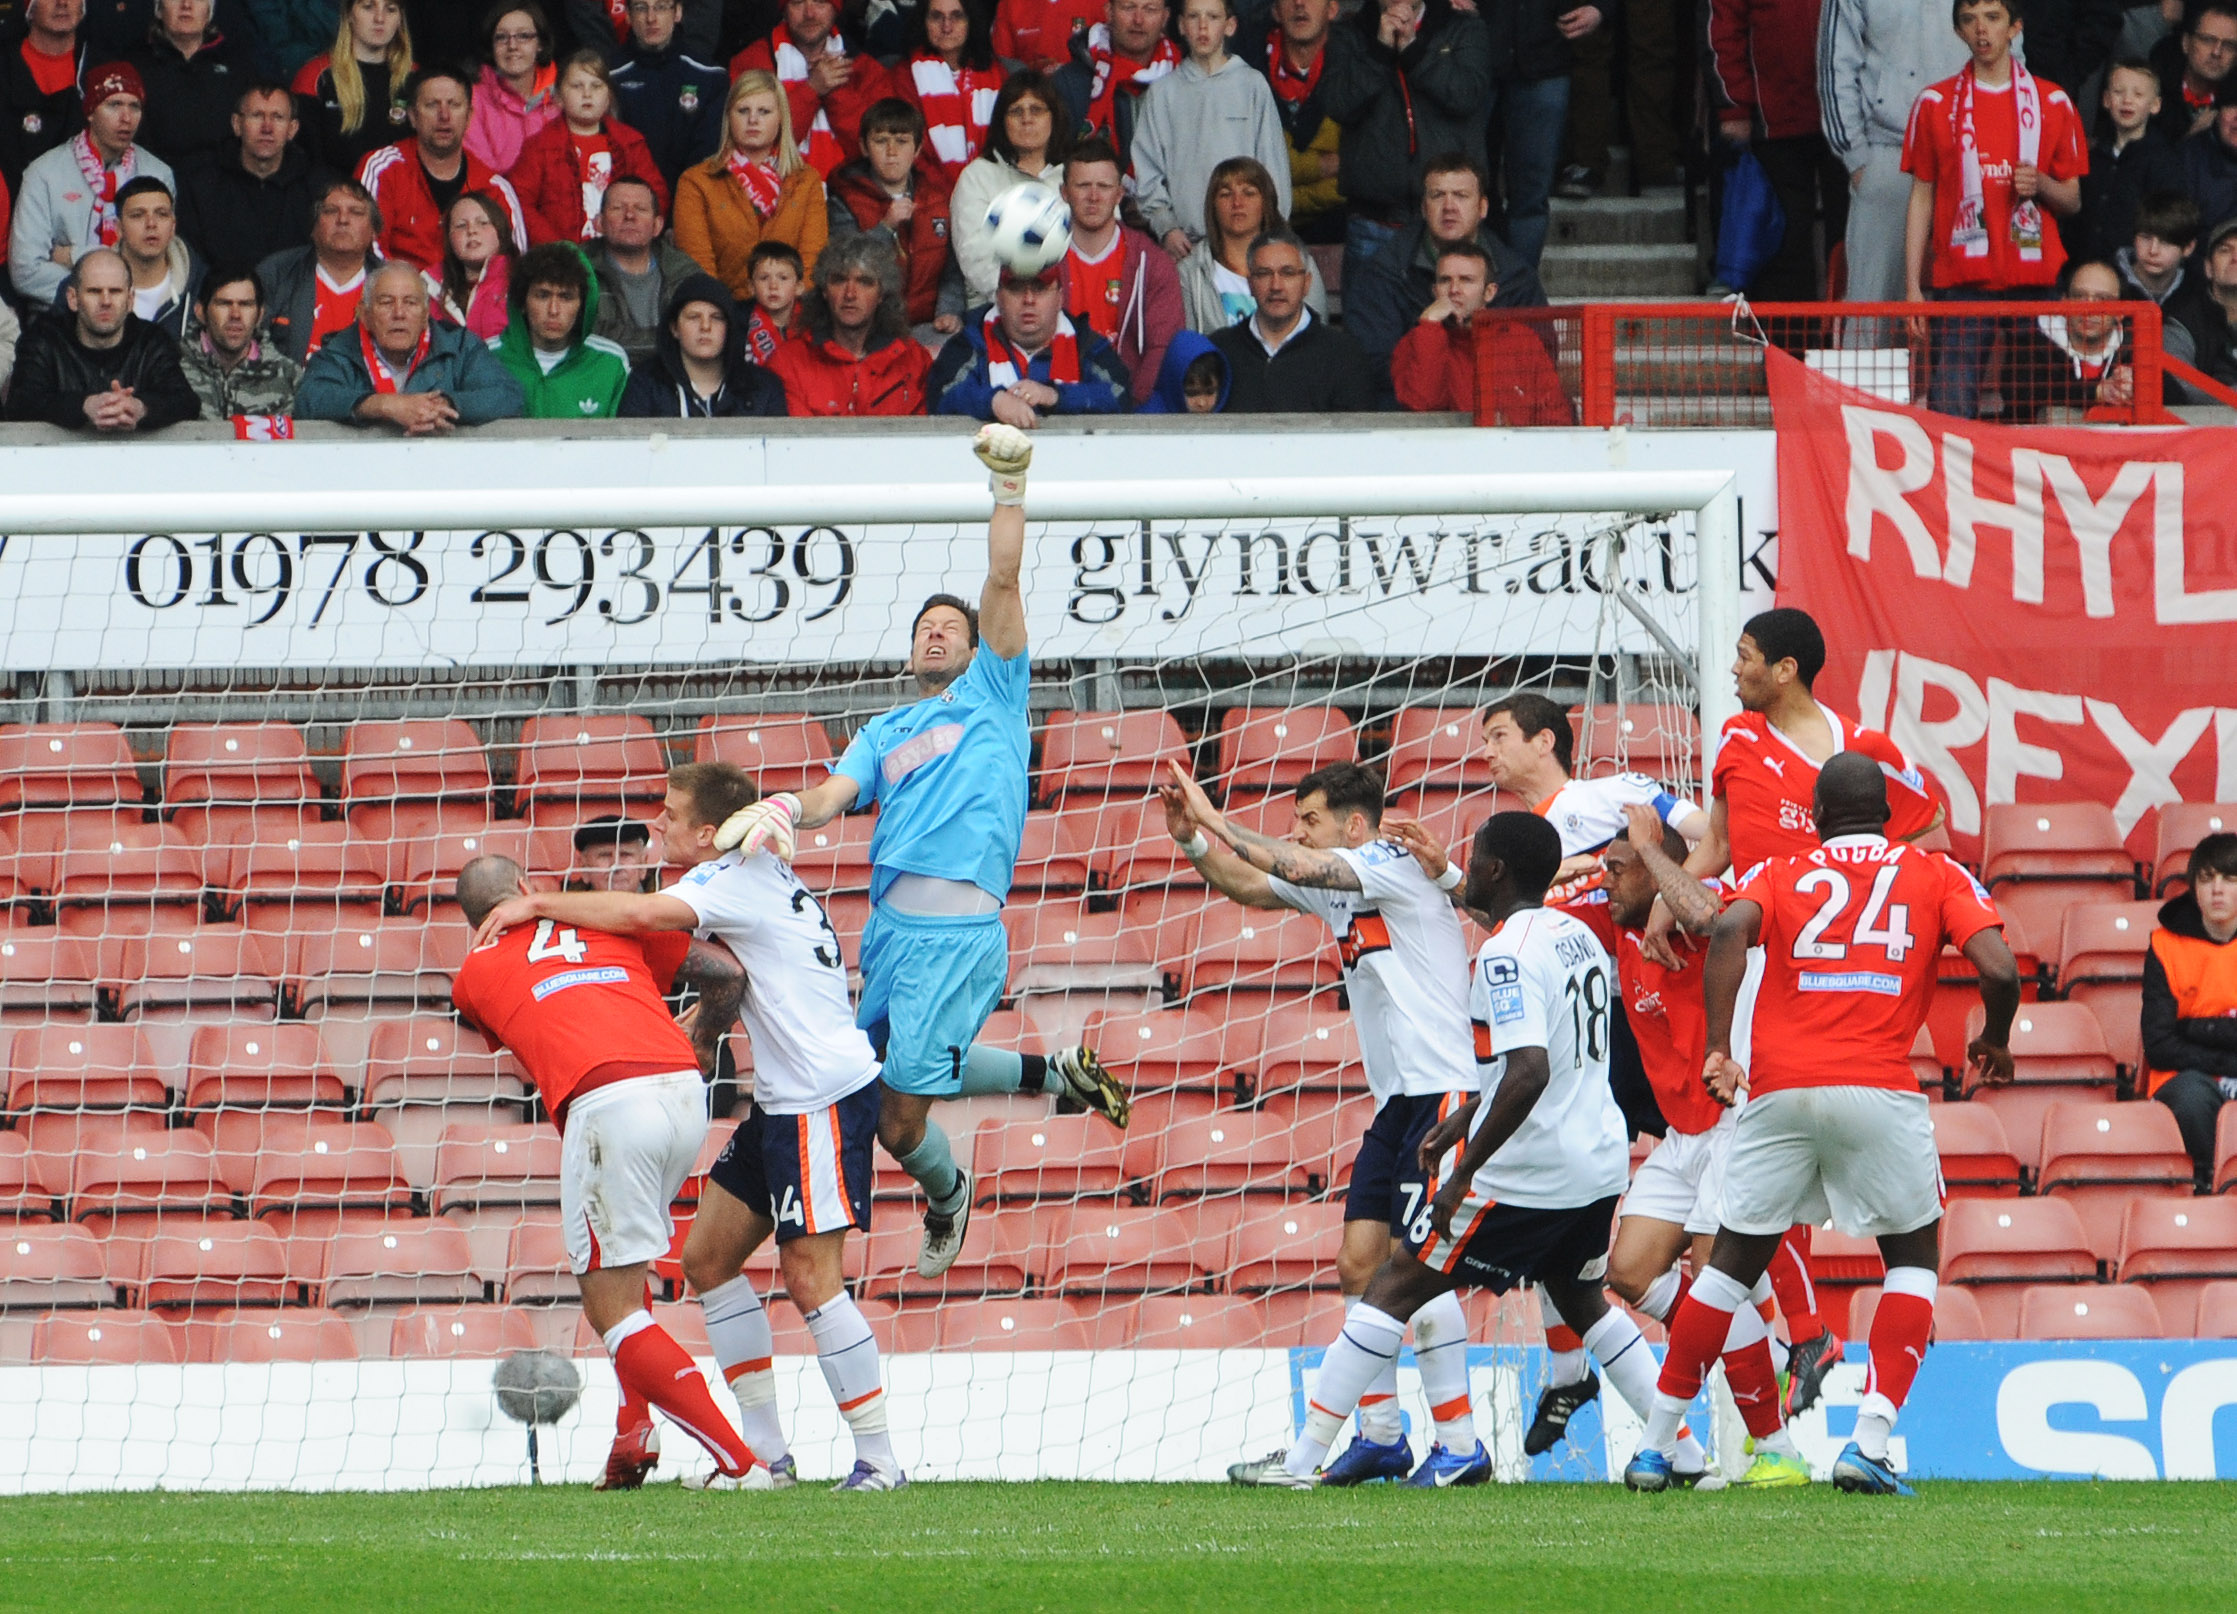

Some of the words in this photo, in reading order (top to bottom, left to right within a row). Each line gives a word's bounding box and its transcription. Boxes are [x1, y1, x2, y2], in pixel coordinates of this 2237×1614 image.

[1841, 405, 2237, 625] RHYL
[125, 531, 430, 629] 01978
[469, 526, 855, 627] 293439
[1068, 496, 1780, 623] glyndwr.ac.uk
[885, 728, 957, 781] asyJet
[1857, 648, 2237, 842] REX
[1808, 844, 1906, 867] POGBA
[790, 889, 843, 968] 3
[1792, 864, 1915, 962] 24
[526, 918, 588, 964] 4
[1554, 933, 1597, 969] OSANO
[535, 969, 629, 998] BLUESQUARE.COM
[1800, 973, 1901, 994] BLUESQUARE.COM
[1565, 965, 1609, 1069] 18
[947, 1045, 961, 1080] 1
[1400, 1182, 1424, 1227] 7
